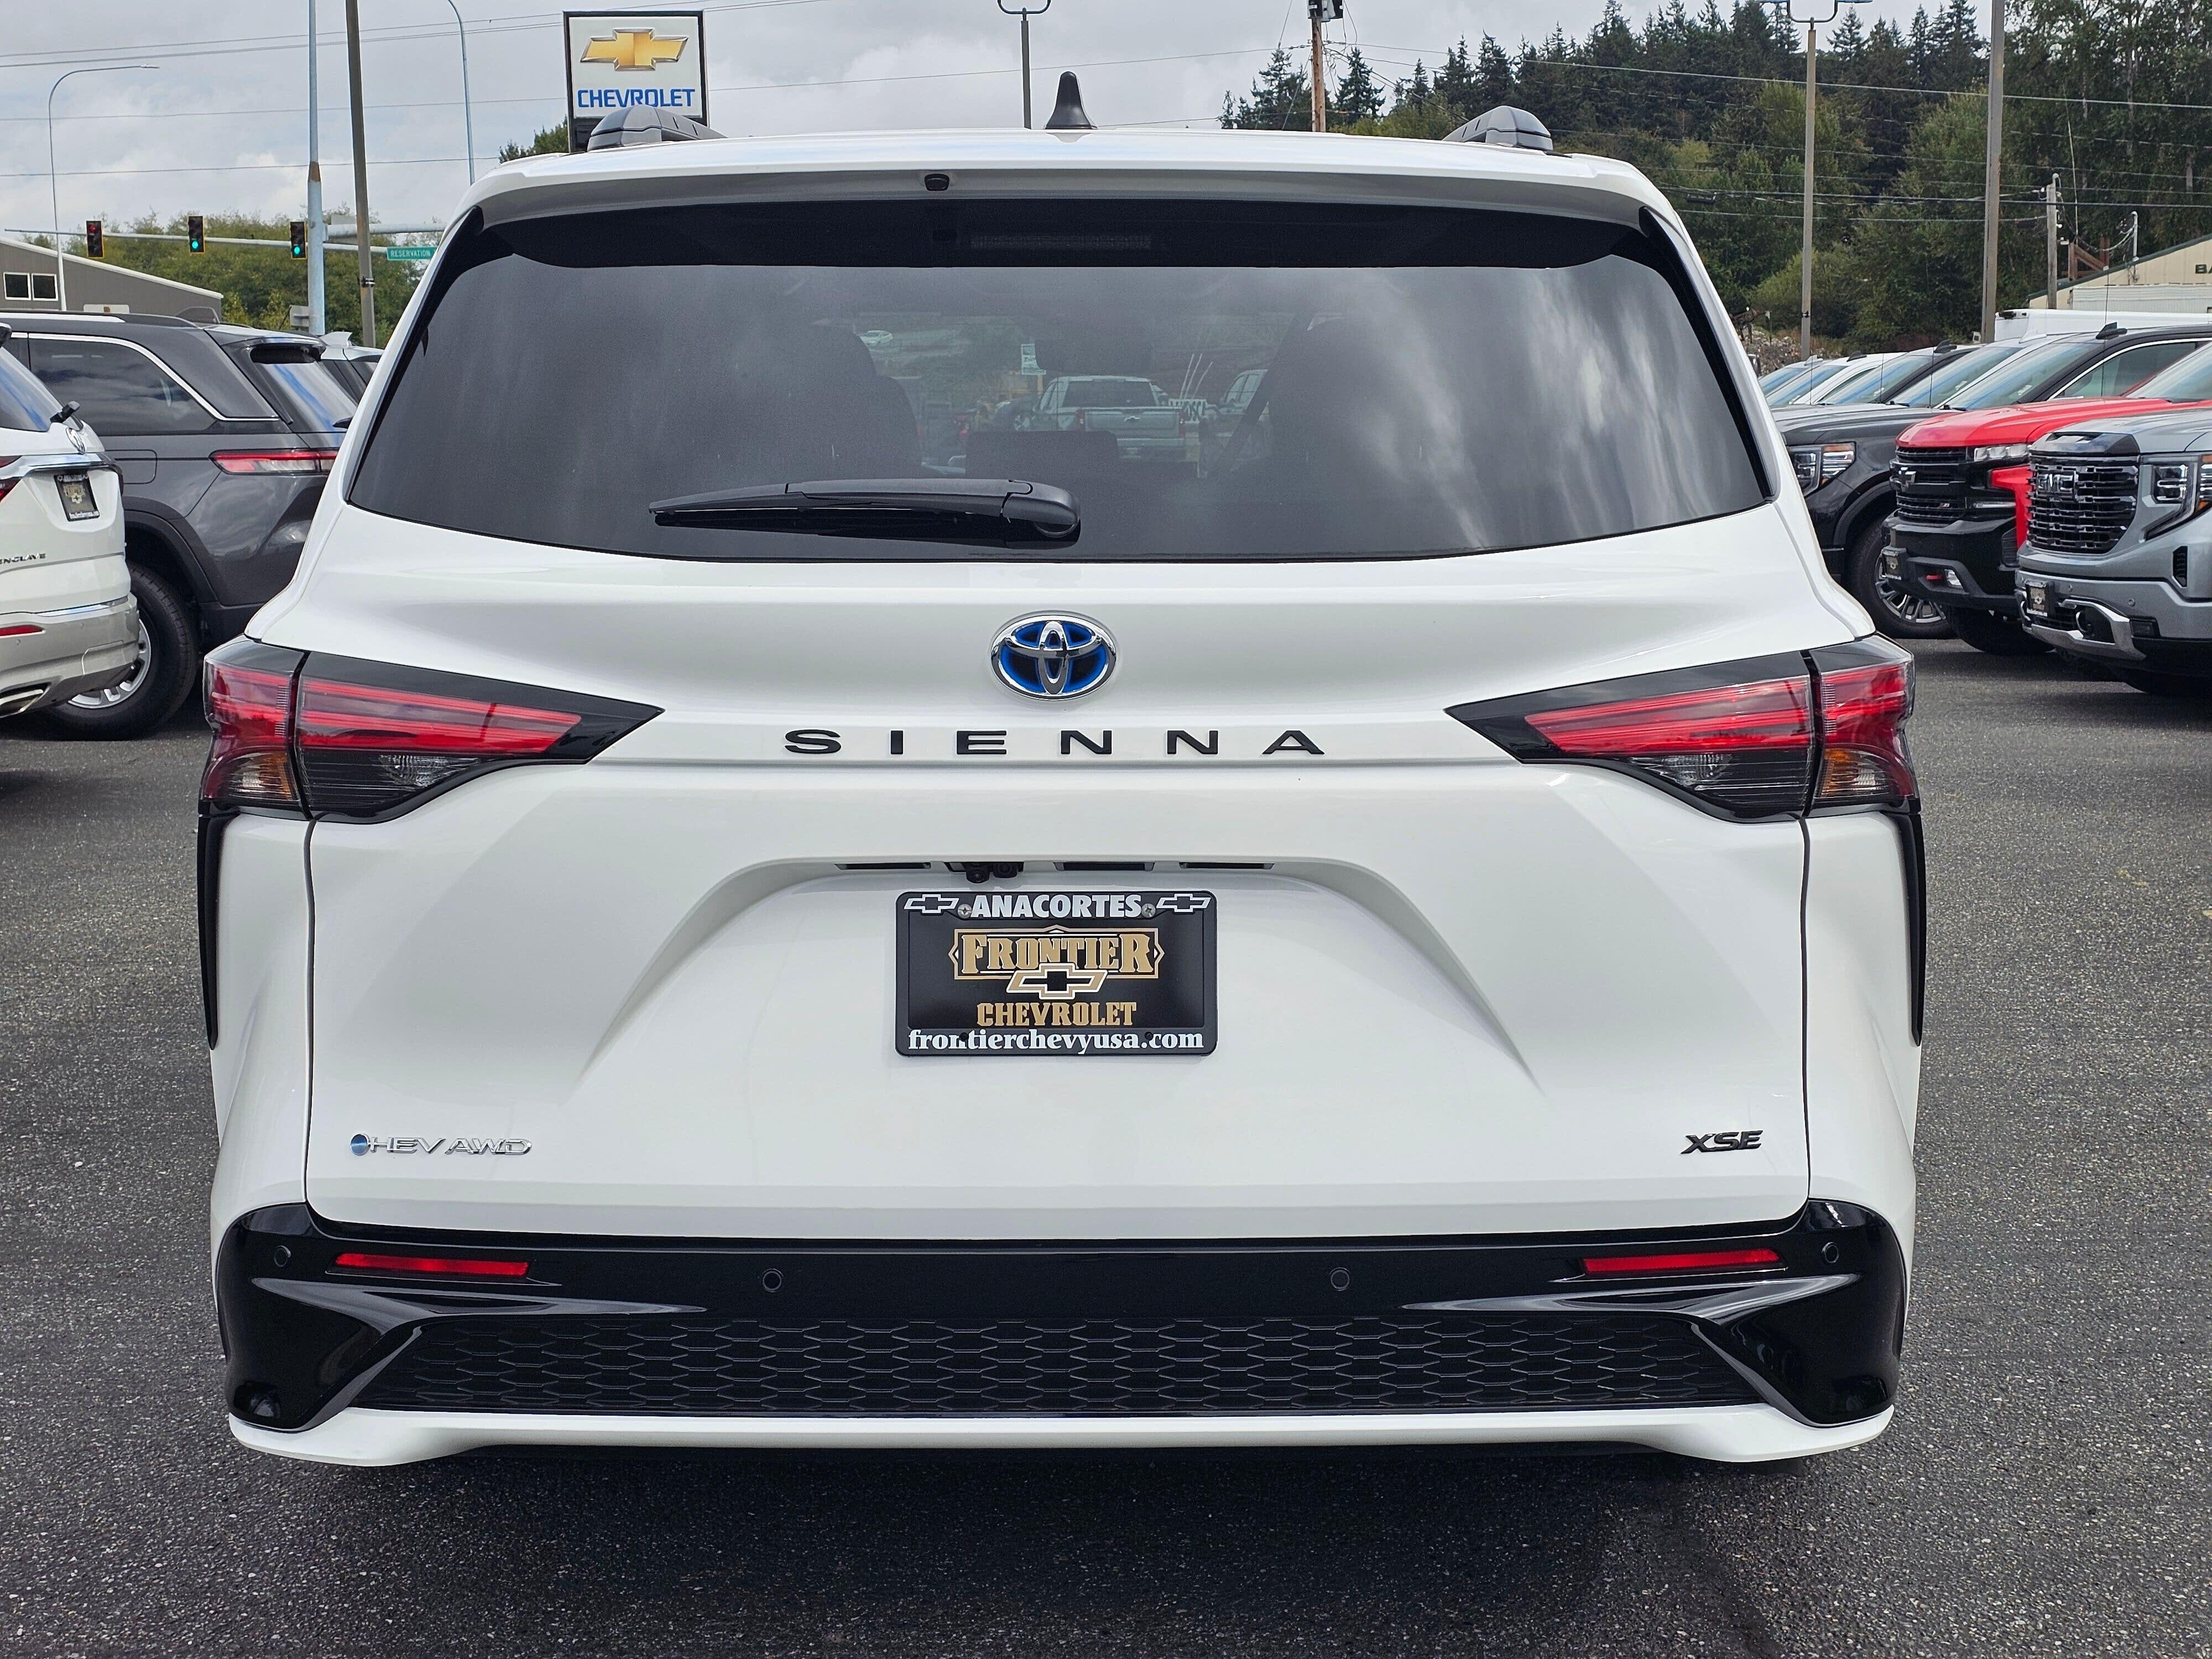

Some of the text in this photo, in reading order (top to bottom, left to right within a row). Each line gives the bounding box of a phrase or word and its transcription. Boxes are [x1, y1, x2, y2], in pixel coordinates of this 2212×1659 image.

[578, 88, 696, 107] CHEVROLET
[2037, 473, 2073, 493] GMC
[785, 729, 1324, 755] SIENNA
[971, 894, 1142, 918] ANACORTES
[961, 933, 1154, 974] FRONTIER
[977, 1001, 1137, 1027] CHEVROLET
[908, 1029, 1204, 1055] frontierchevyusa.com
[368, 1136, 531, 1155] HEV AWD
[1680, 1130, 1764, 1154] XSE
